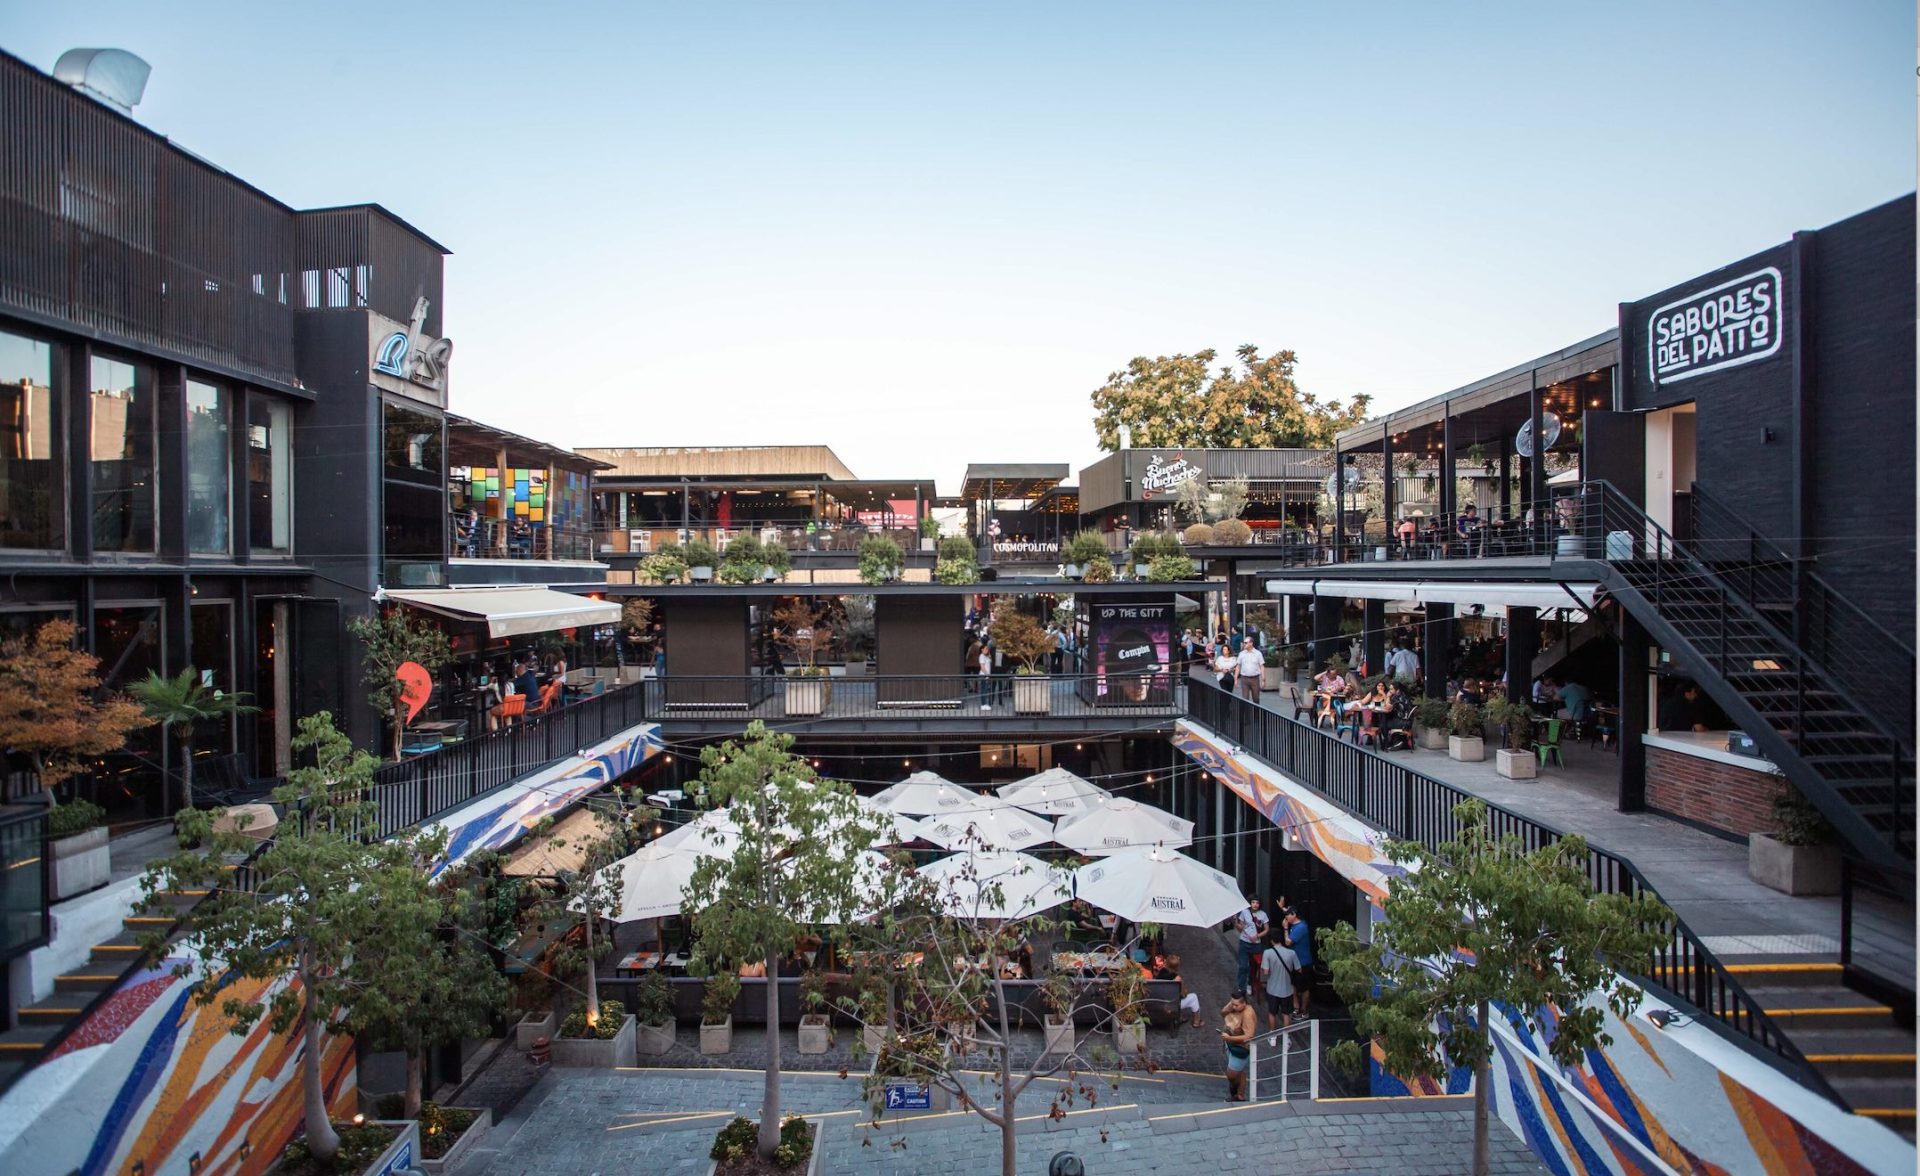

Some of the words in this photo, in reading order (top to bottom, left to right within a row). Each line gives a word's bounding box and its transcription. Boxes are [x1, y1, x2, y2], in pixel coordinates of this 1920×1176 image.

[1656, 282, 1770, 345] SABORES
[1657, 341, 1690, 369] DEL
[1692, 315, 1768, 363] PATIO
[1146, 458, 1188, 478] Buenos
[993, 543, 1059, 553] COSMOPOLITAN
[1119, 608, 1137, 618] THE
[1140, 607, 1164, 618] CITY
[1151, 897, 1186, 910] AUSTRAL
